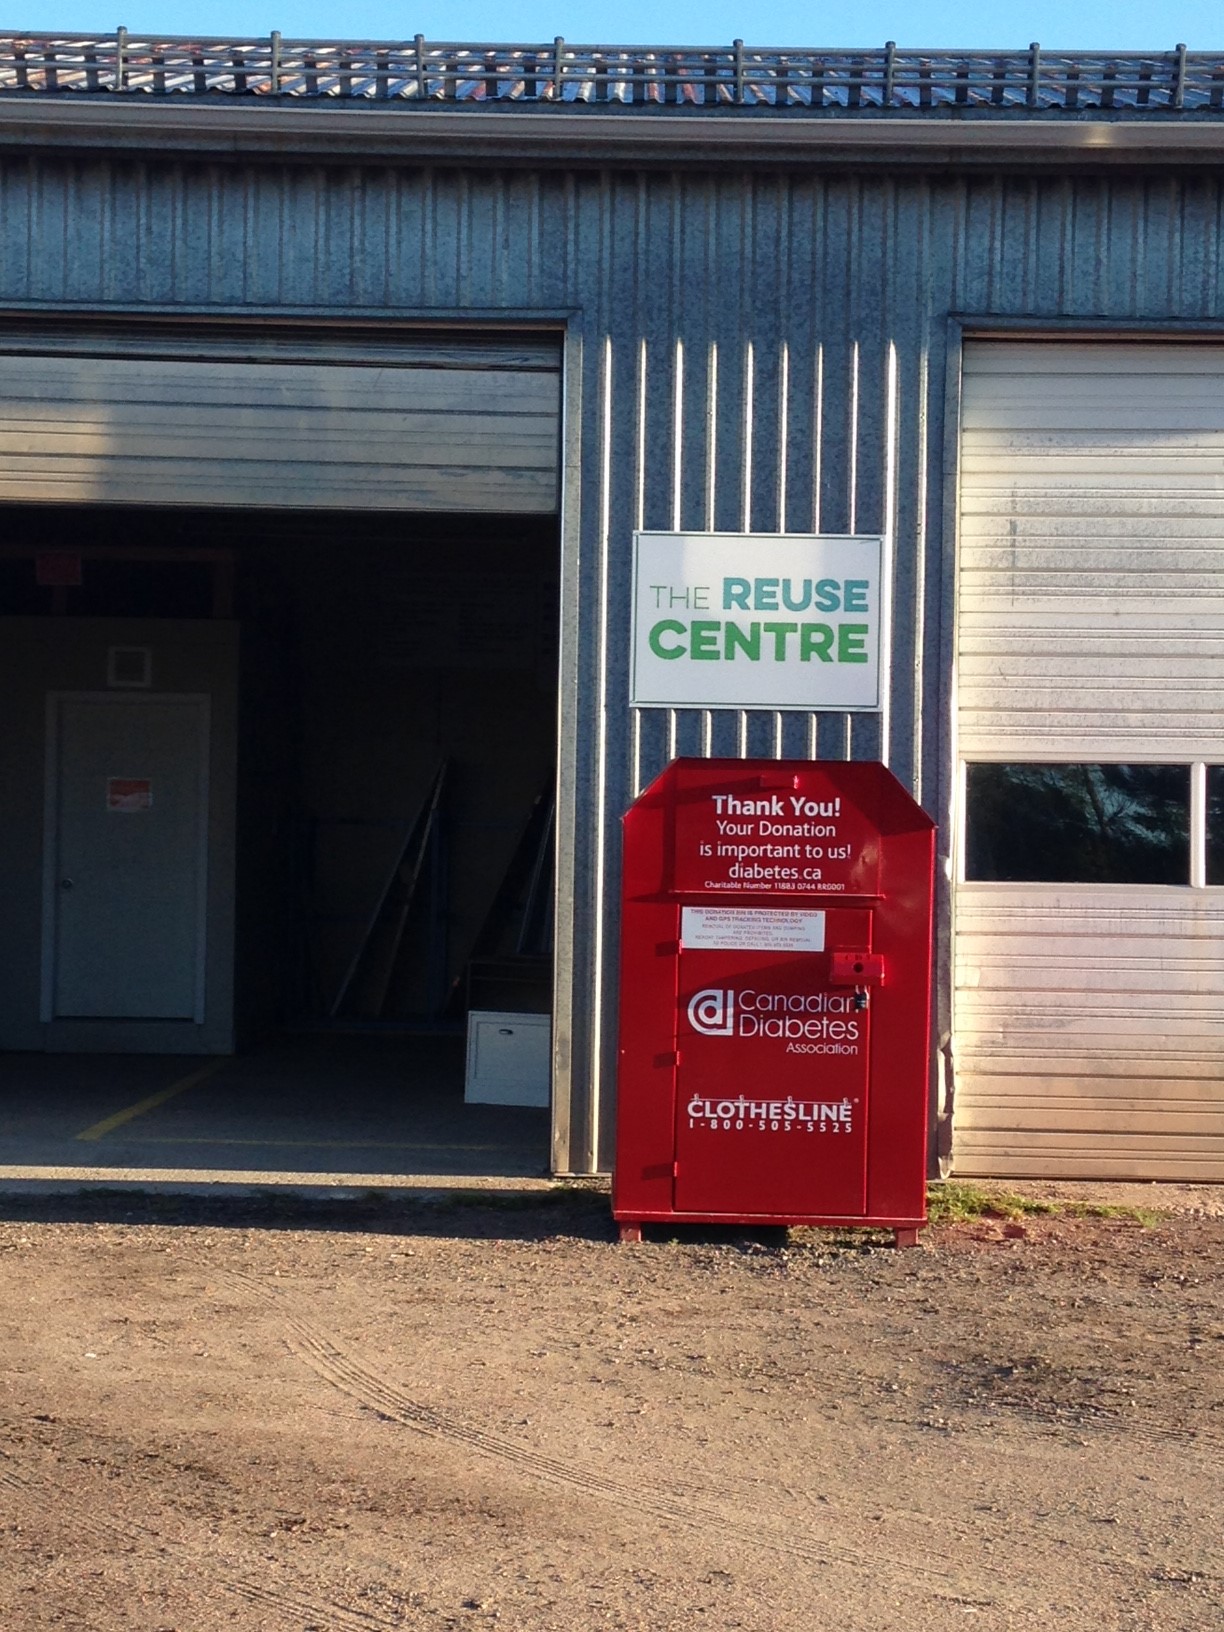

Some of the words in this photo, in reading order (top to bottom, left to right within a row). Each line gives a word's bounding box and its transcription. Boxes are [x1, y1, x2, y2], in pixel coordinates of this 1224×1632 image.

[649, 585, 711, 610] THE
[722, 577, 870, 612] REUSE
[649, 619, 869, 663] CENTRE
[711, 794, 785, 815] Thank
[790, 796, 841, 817] You!
[716, 820, 754, 836] Your
[759, 821, 836, 837] Donation
[699, 840, 713, 856] is
[717, 841, 801, 862] important
[805, 844, 823, 859] to
[828, 844, 851, 860] us!
[728, 862, 822, 880] diabetes.ca
[704, 880, 742, 889] Charitable
[742, 881, 772, 890] Number
[738, 990, 859, 1013] Canadian
[739, 1014, 859, 1040] Diabetes
[785, 1042, 859, 1055] Association
[687, 1101, 852, 1122] CLOTHESLINE
